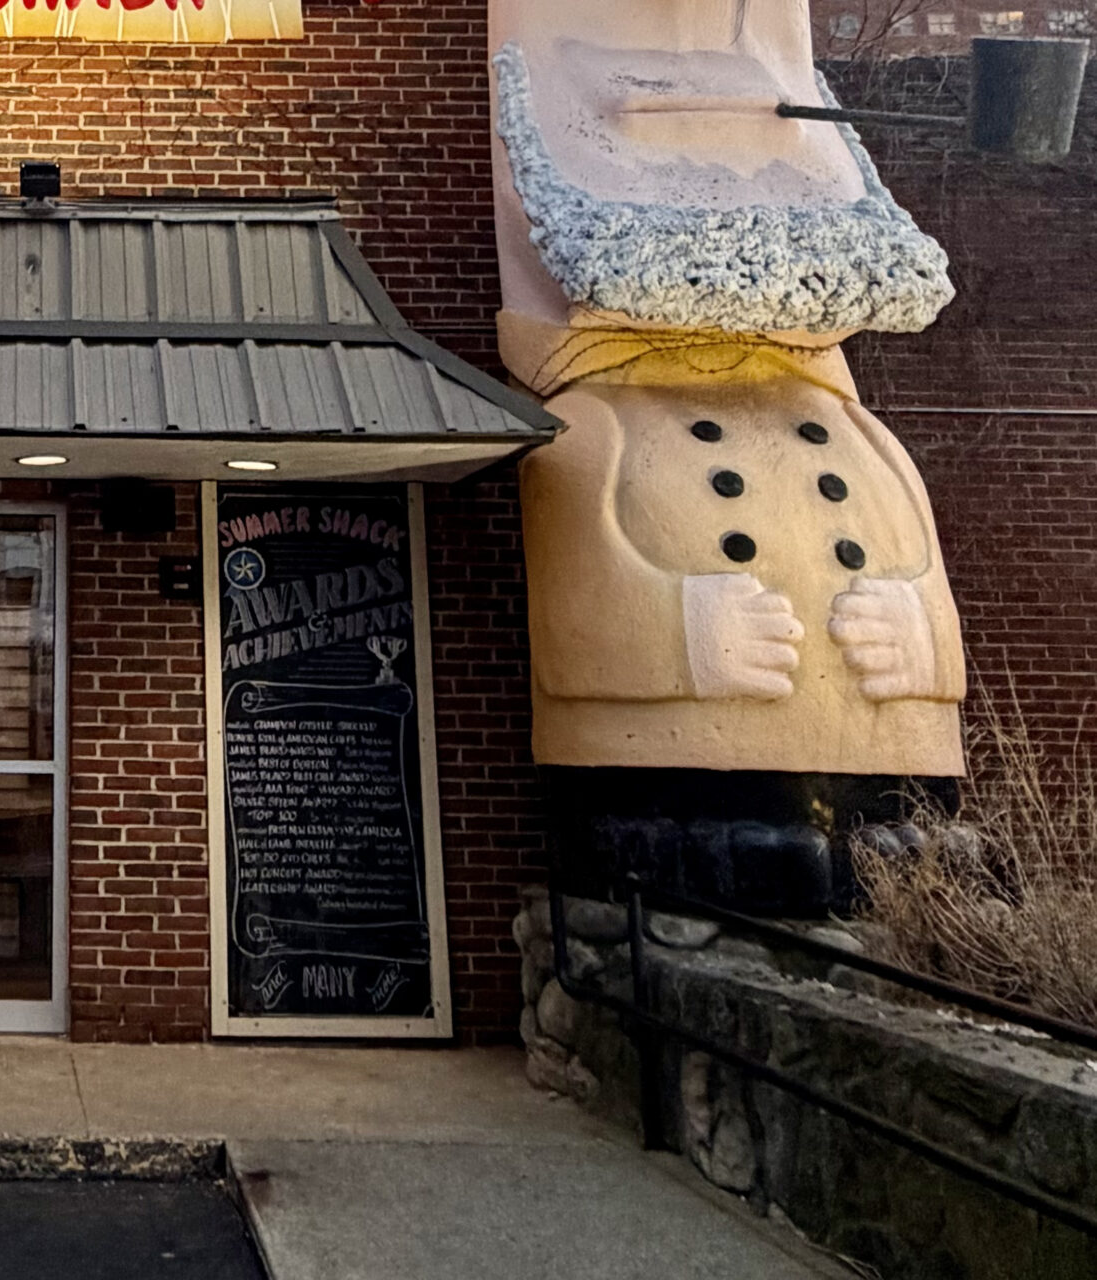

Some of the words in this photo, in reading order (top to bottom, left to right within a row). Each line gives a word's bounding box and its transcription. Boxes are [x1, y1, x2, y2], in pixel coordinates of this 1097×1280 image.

[218, 505, 311, 549] SUMMER
[318, 505, 407, 552] SHACK
[223, 557, 406, 639] AWARDS
[261, 964, 288, 1002] and
[302, 963, 357, 999] MANY
